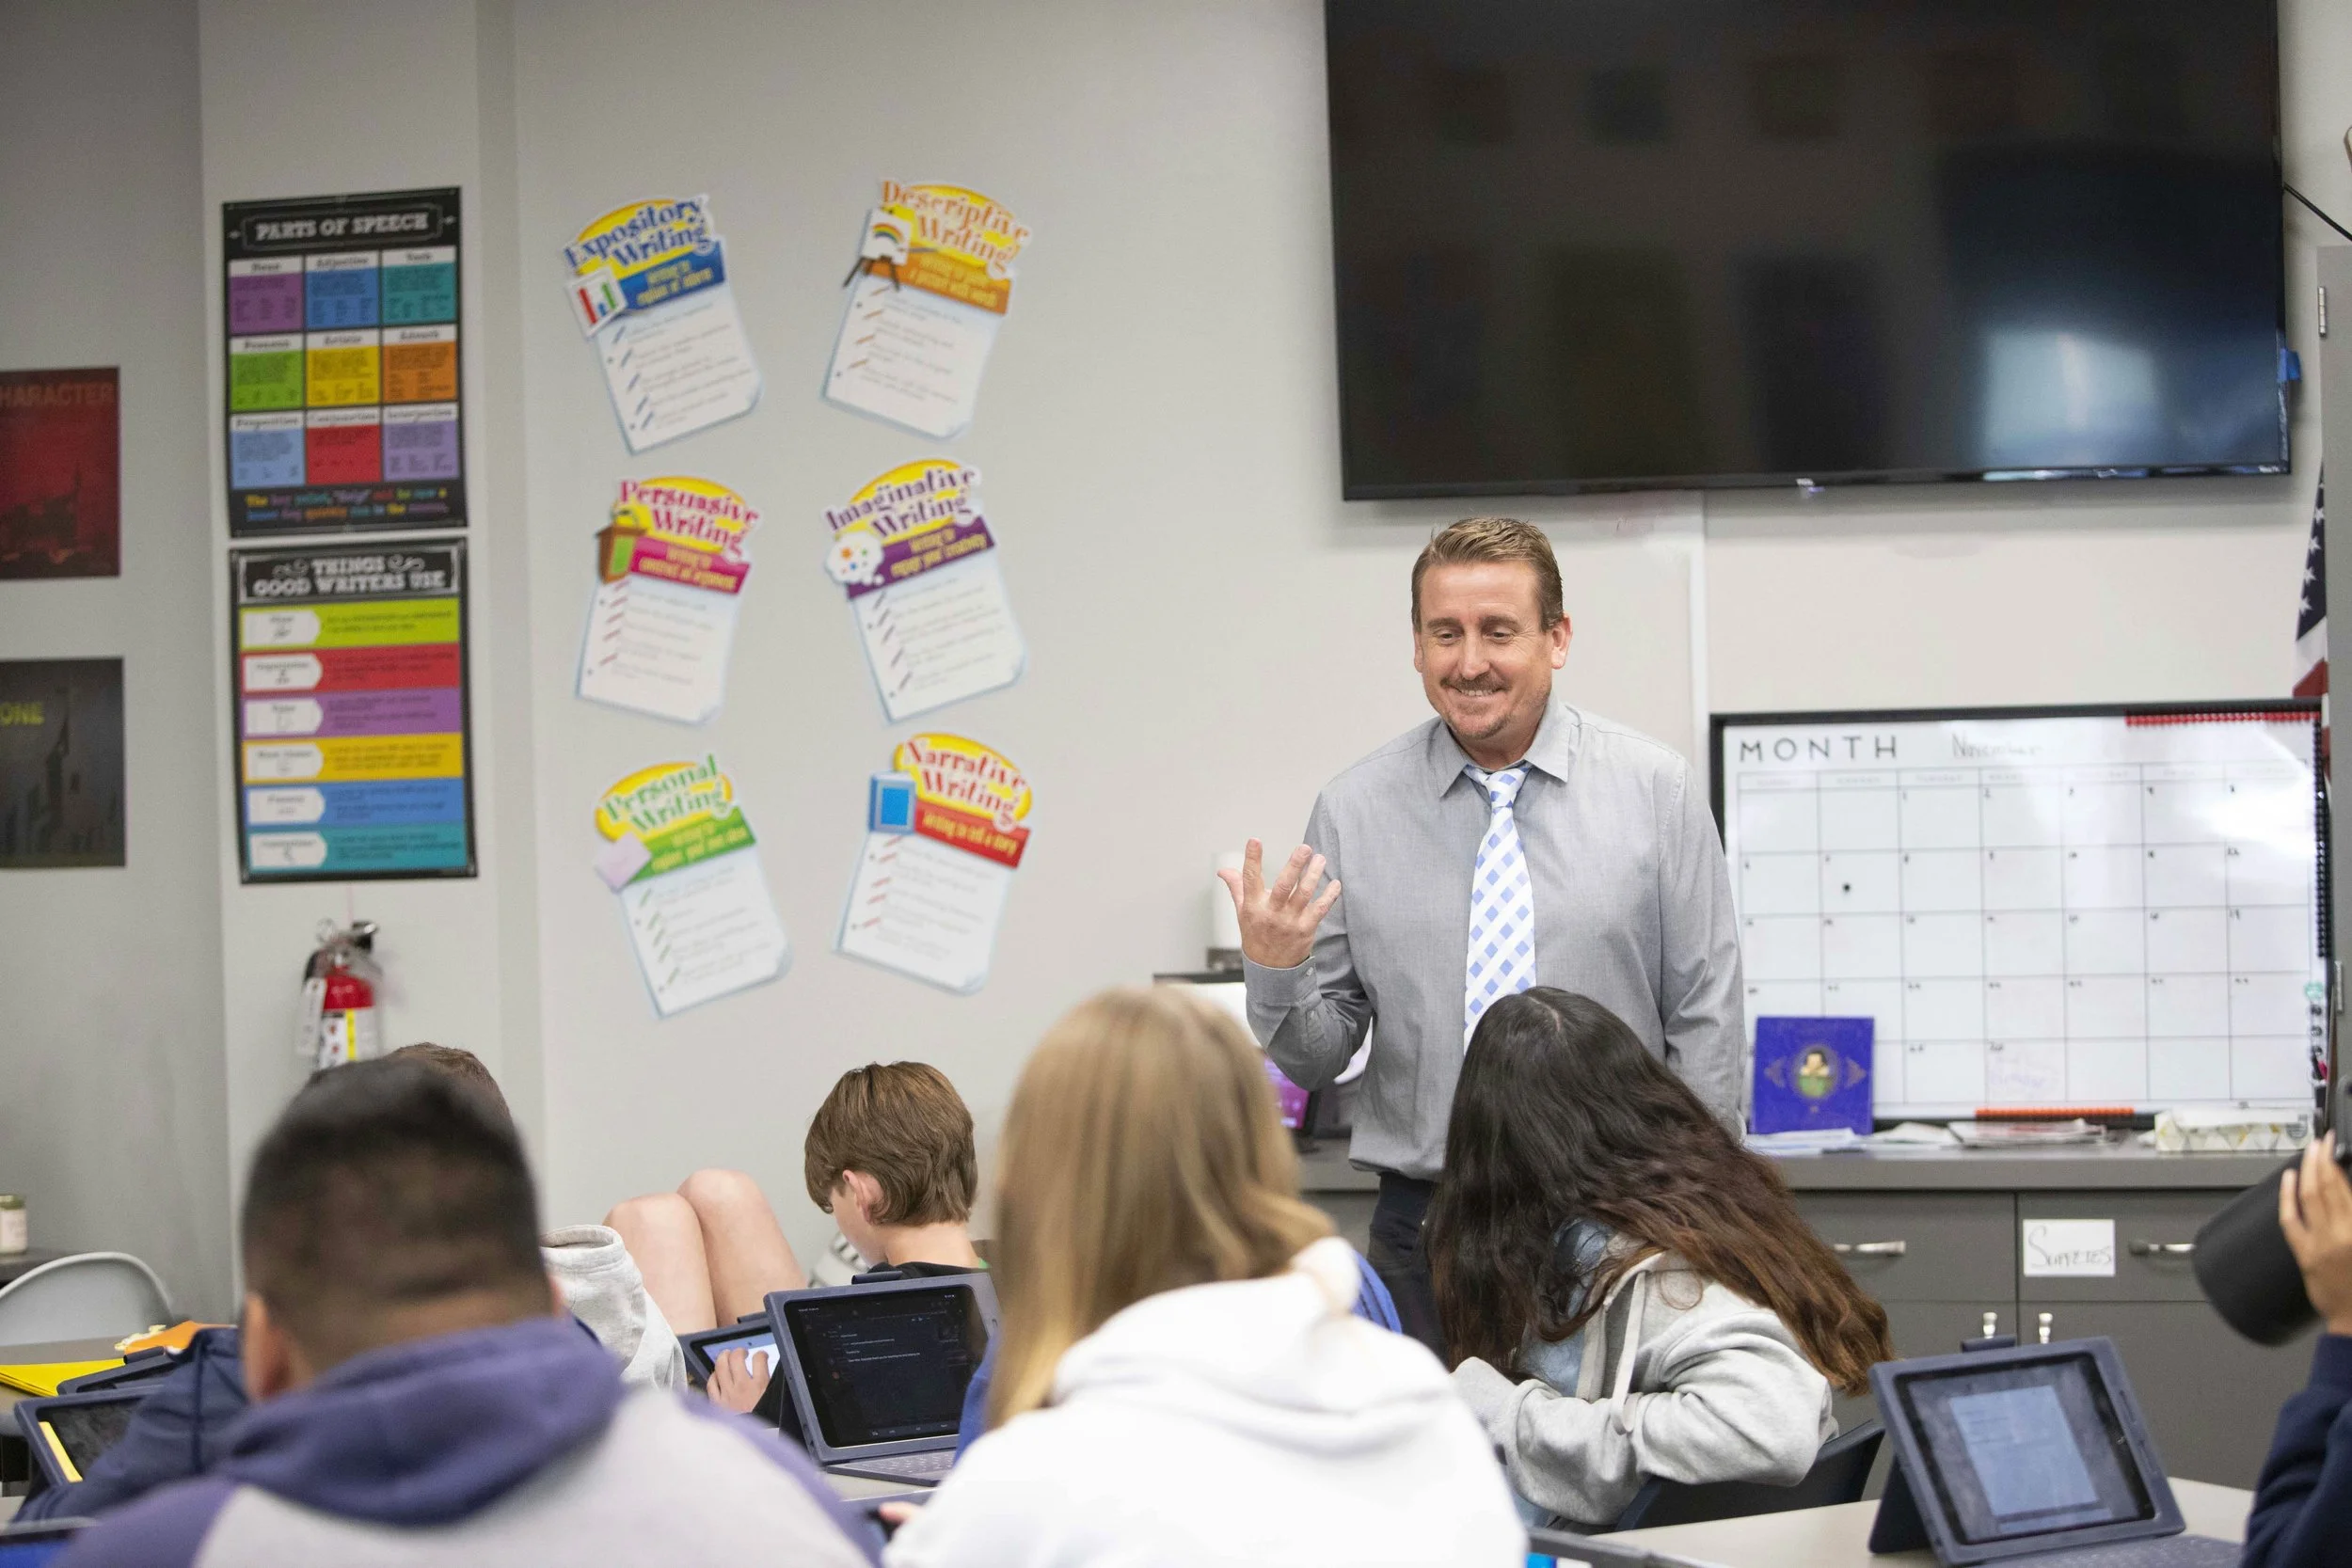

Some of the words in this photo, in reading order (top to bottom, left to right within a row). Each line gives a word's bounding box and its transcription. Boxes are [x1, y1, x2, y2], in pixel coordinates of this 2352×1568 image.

[255, 219, 317, 241] PARTS
[320, 217, 349, 236] OF
[352, 212, 429, 233] SPEECH
[882, 180, 1029, 239] Descriptive
[564, 198, 704, 268] Expository
[612, 225, 711, 267] Writing
[917, 216, 1013, 274] Writing
[620, 480, 760, 522] Persuasive
[825, 469, 976, 532] Imaginative
[871, 496, 972, 538] Writing
[651, 509, 747, 557] Writing
[252, 577, 312, 596] GOOD
[313, 572, 405, 594] WRITERS
[408, 570, 446, 589] USE
[310, 557, 385, 577] THINGS
[907, 739, 1027, 792] Narrative
[1740, 735, 1898, 763] MONTH
[605, 753, 718, 822] Personal
[922, 769, 1018, 825] Writing
[630, 789, 728, 833] Writing
